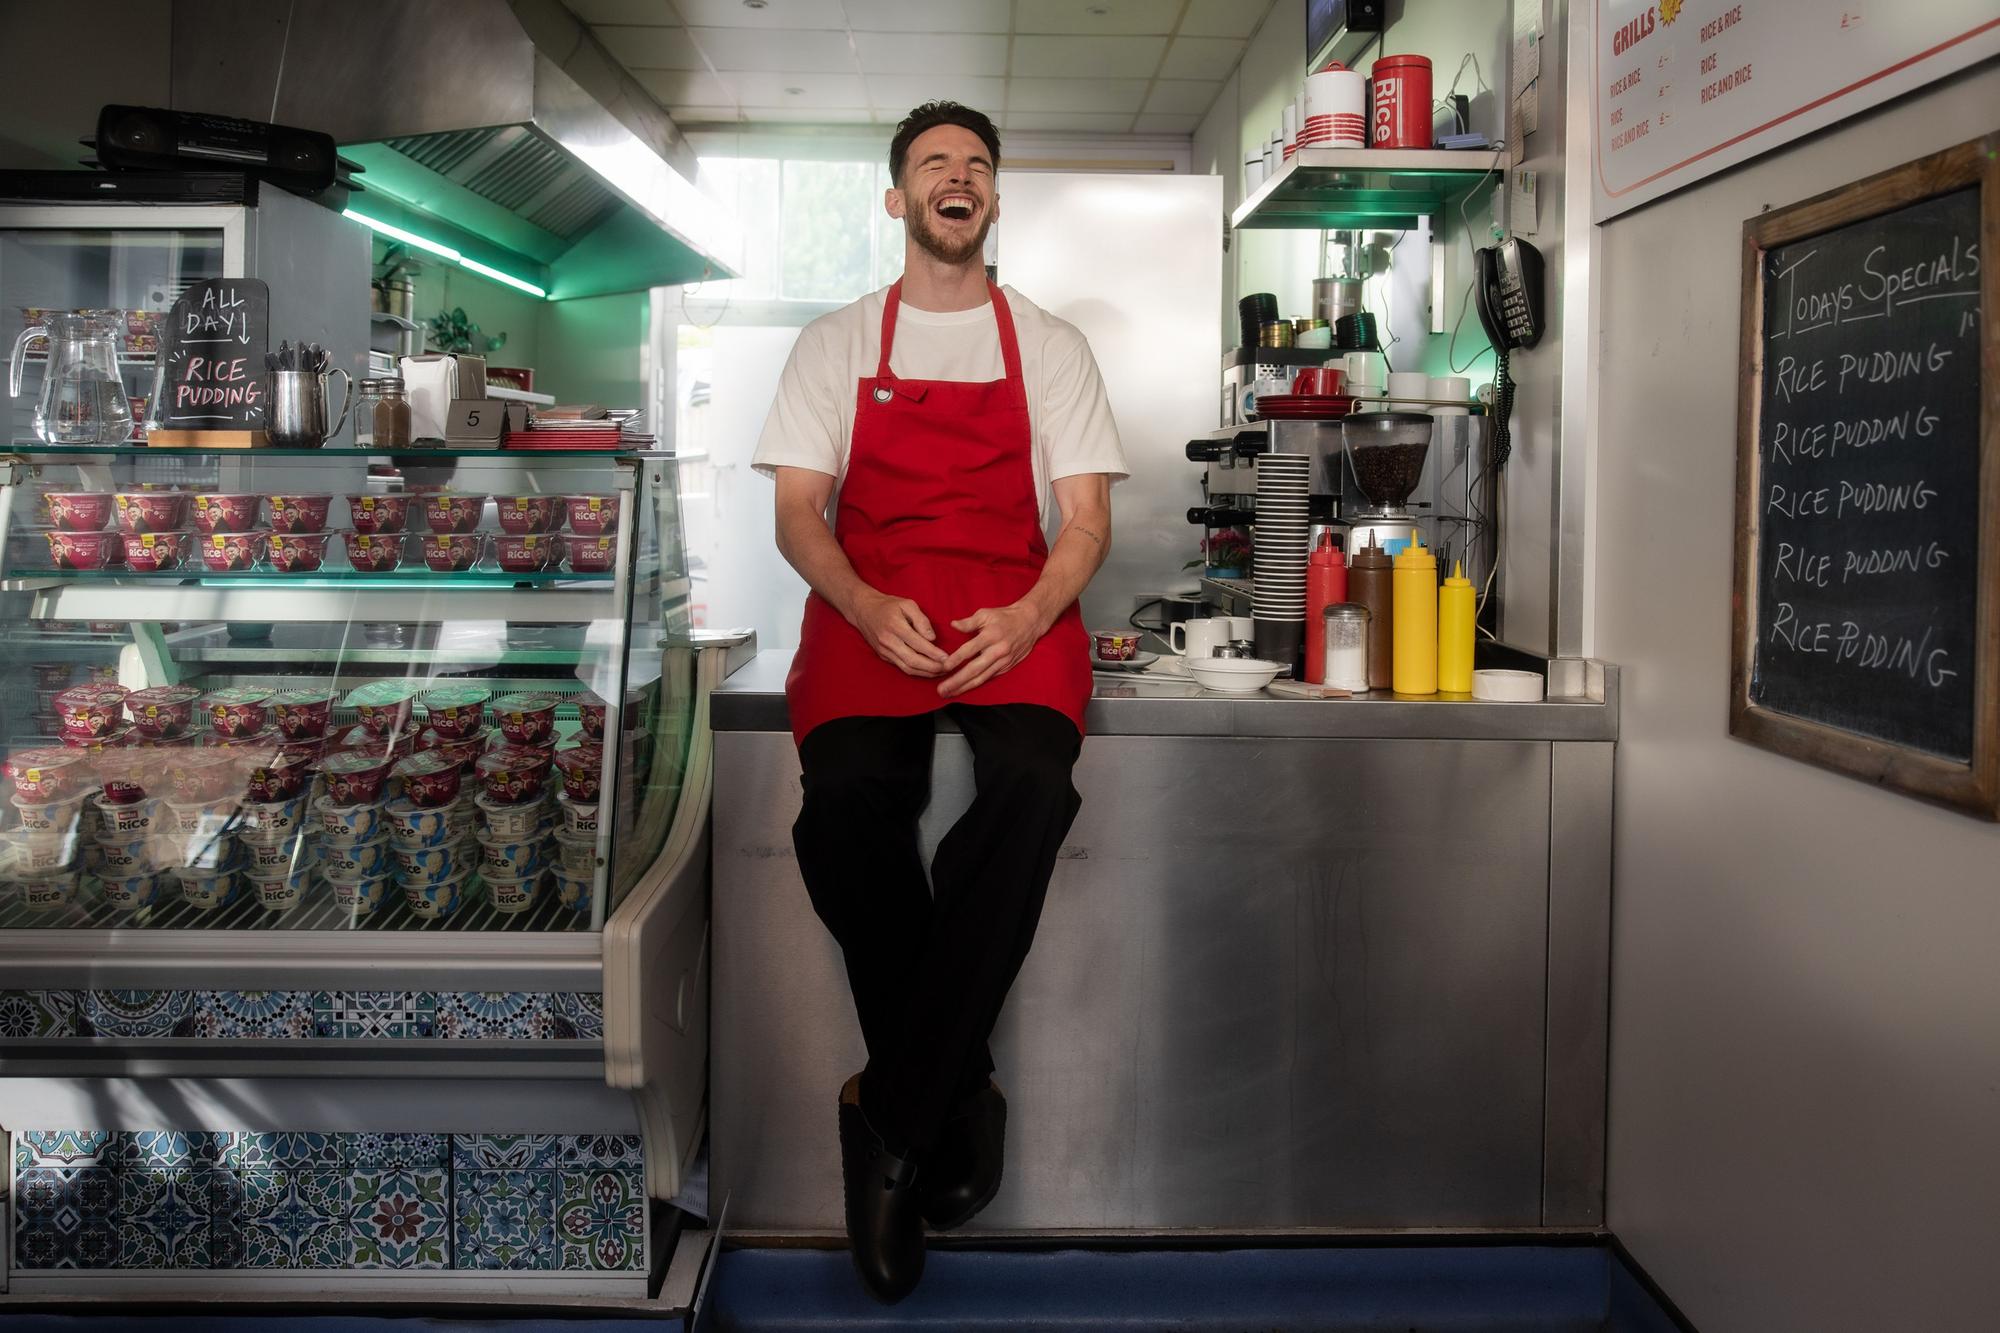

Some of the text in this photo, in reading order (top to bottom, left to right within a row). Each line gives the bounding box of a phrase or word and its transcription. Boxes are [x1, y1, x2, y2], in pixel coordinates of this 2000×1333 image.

[1613, 6, 1655, 57] GRILLS
[1700, 4, 1742, 44] RICE & RICE
[1701, 53, 1717, 75] RICE
[1610, 78, 1622, 99] RICE
[1628, 68, 1641, 90] RICE
[1701, 64, 1752, 104] RICE AND RICE
[1376, 78, 1396, 141] Rice
[1610, 107, 1623, 126] RICE
[1611, 119, 1649, 152] RICE AND RICE
[203, 288, 244, 309] ALL
[187, 312, 234, 335] DAY
[185, 357, 247, 381] RICE
[1775, 342, 1953, 403] RICE PUDDING
[177, 381, 261, 408] PUDDING
[467, 411, 480, 426] 5
[1772, 406, 1940, 465] RICE PUDDING
[1767, 480, 1938, 519] RICE PUDDING
[503, 511, 524, 520] Rice
[575, 512, 596, 520] Rice
[128, 548, 150, 557] Rice
[507, 550, 530, 559] Rice
[582, 550, 604, 559] Rice
[1775, 541, 1949, 587] RICE PUDDING
[1770, 602, 1958, 687] RICE PUDDING
[119, 818, 150, 831] Rice
[259, 854, 288, 865] Rice
[30, 891, 60, 903] Rice
[265, 889, 294, 901] Rice
[498, 893, 527, 904] Rice
